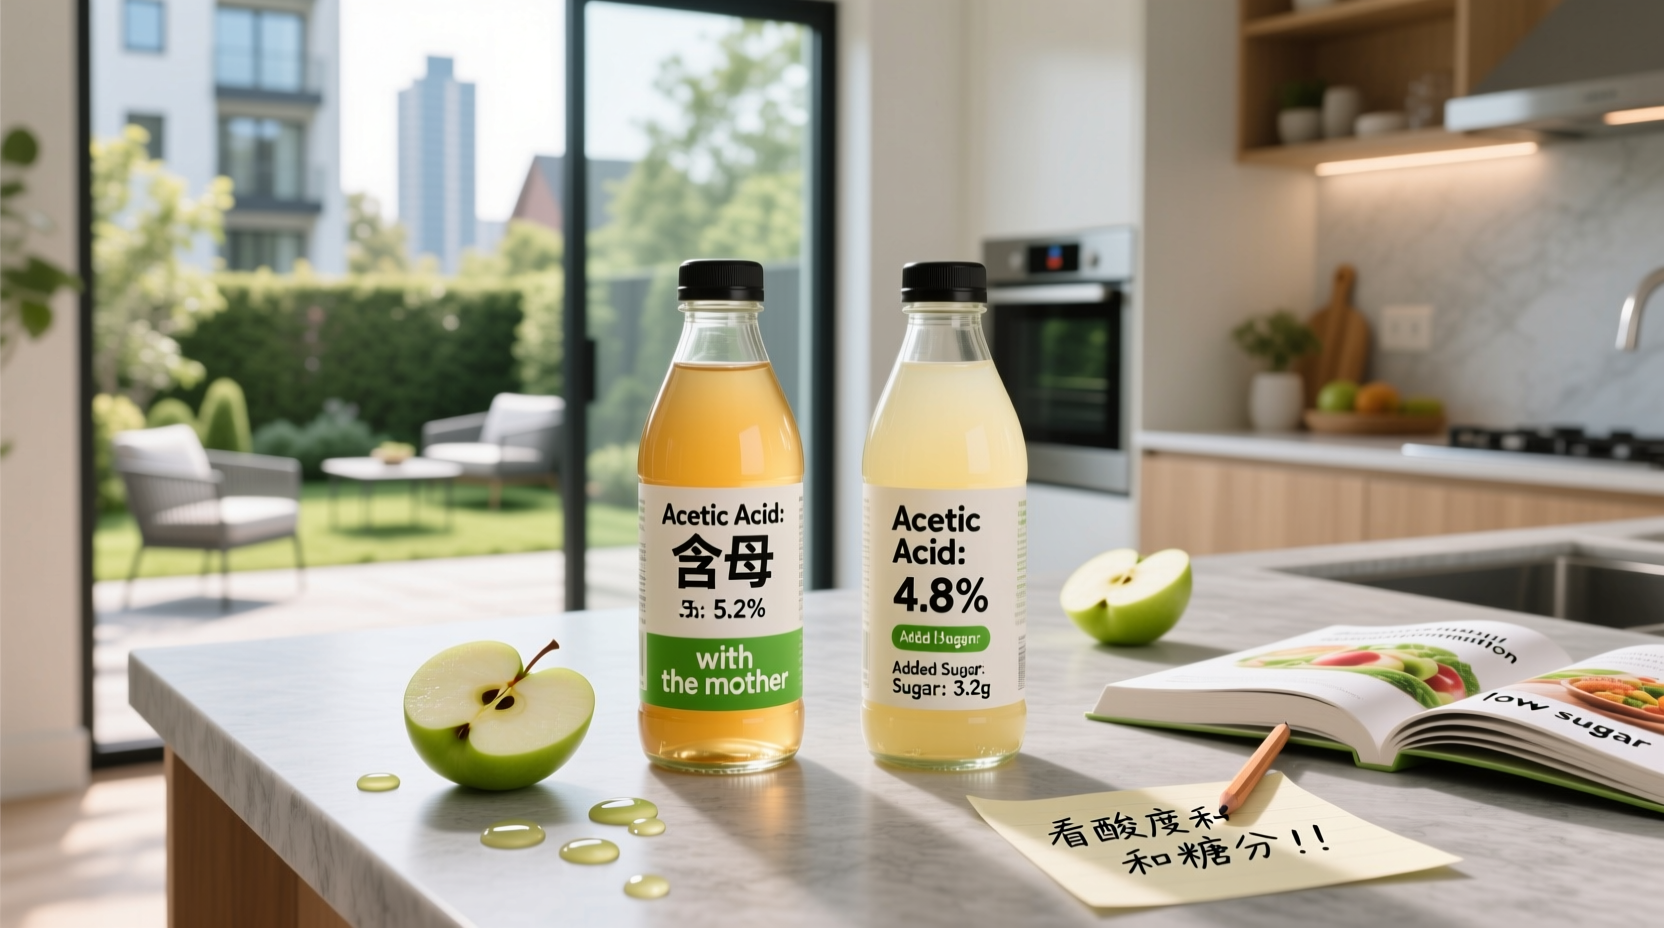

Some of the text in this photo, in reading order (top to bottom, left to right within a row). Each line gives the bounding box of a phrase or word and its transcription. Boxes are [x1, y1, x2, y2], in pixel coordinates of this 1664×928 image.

[661, 501, 785, 526] Acetic Acid:
[891, 504, 981, 533] Acetic
[671, 532, 775, 590] 含母
[892, 537, 966, 566] Acid:
[713, 597, 767, 620] 5.2%
[892, 576, 990, 614] 4.8%
[695, 643, 753, 670] with
[891, 660, 937, 676] Added
[660, 668, 789, 696] the mother
[892, 677, 991, 700] Sugar: 3.2g
[1482, 692, 1652, 748] low sugar
